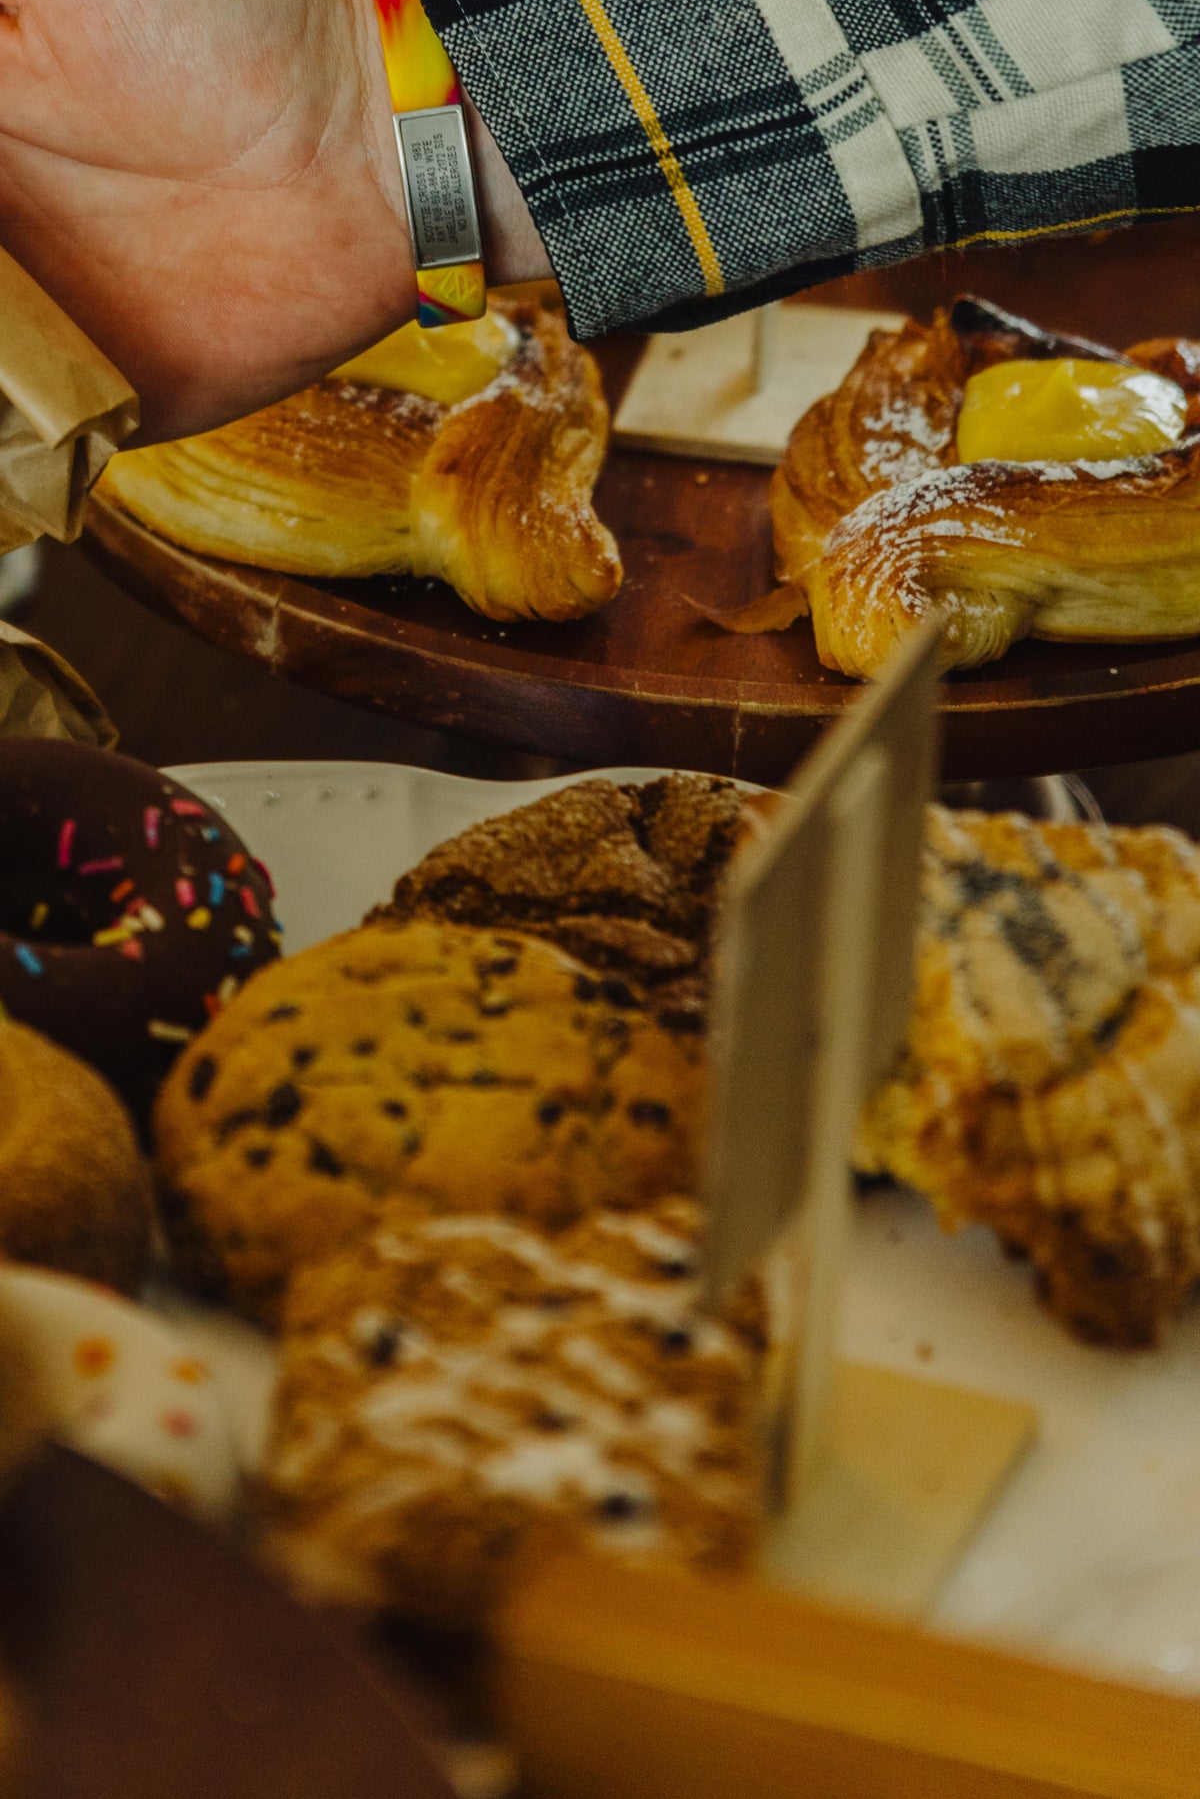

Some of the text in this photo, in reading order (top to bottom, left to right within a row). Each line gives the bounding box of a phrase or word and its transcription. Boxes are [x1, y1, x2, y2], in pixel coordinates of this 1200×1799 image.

[422, 139, 434, 162] WIFE
[433, 133, 444, 148] SIS
[445, 144, 462, 194] ALLERGIES
[415, 172, 429, 203] CROSS
